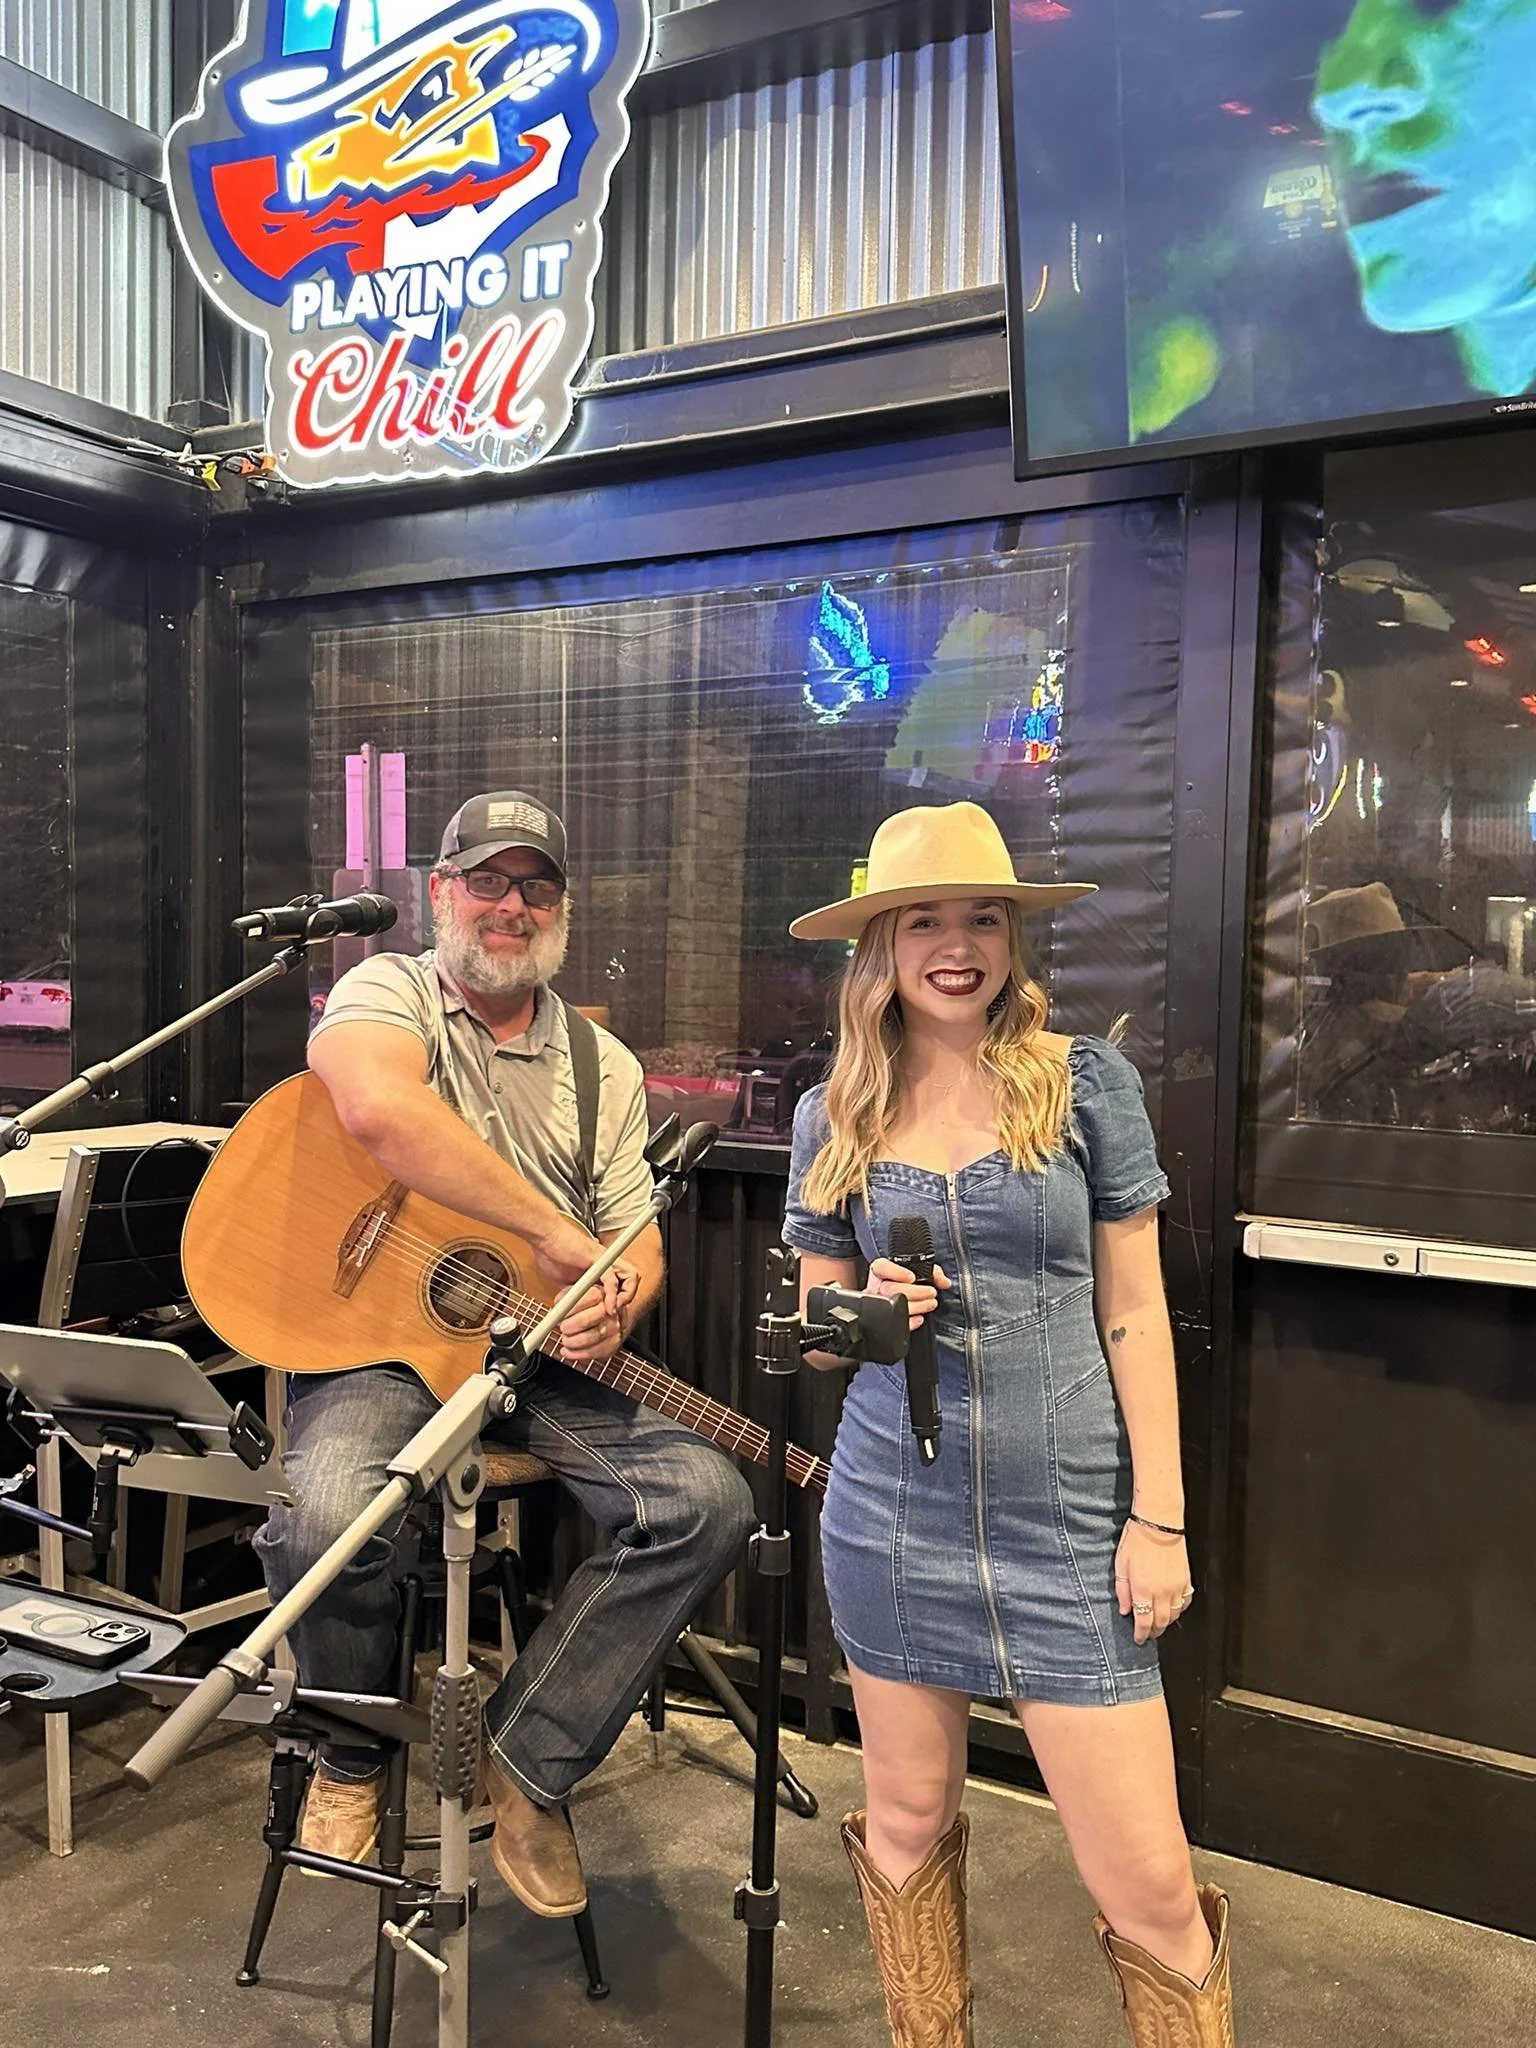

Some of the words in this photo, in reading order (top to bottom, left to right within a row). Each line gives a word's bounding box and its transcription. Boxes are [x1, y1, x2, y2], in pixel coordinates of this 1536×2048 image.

[291, 253, 509, 332] PLAYING
[521, 240, 572, 303] IT
[289, 309, 566, 457] Chill
